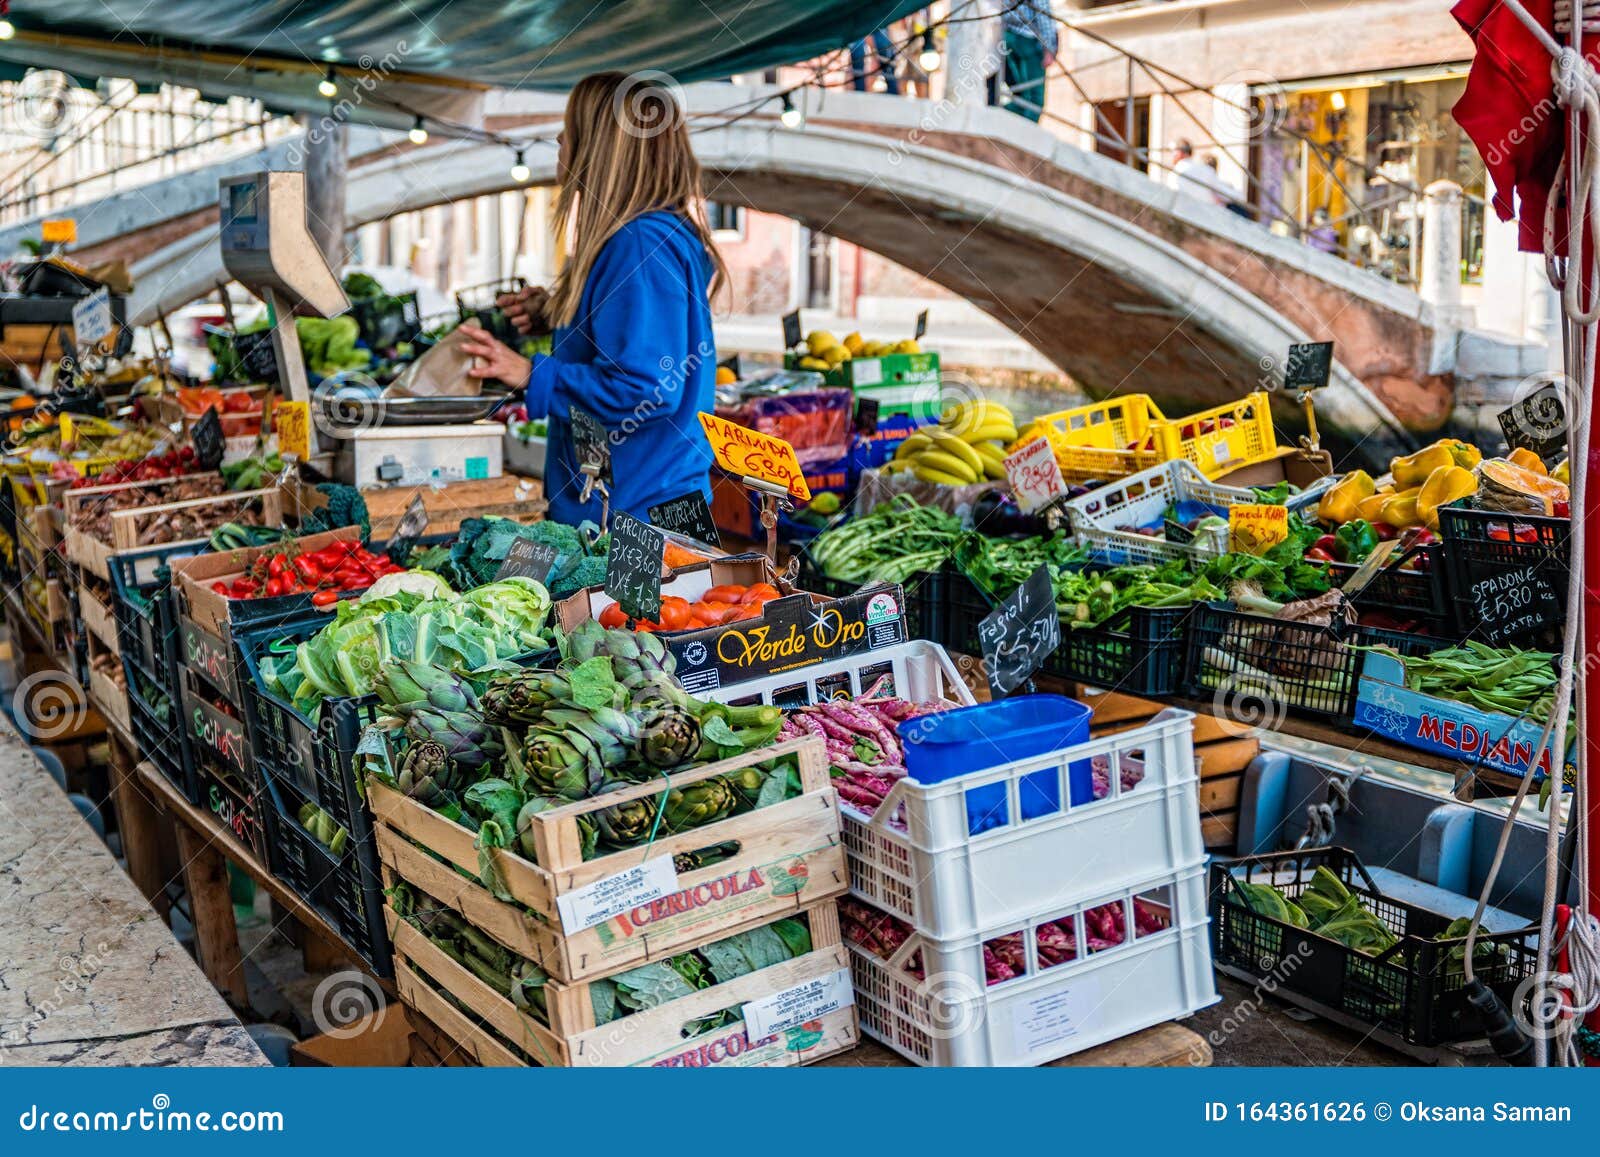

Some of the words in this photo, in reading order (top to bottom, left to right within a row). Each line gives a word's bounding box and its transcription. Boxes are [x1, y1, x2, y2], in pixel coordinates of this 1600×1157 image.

[1472, 566, 1537, 603] SPADONE
[717, 623, 806, 668] Verde
[812, 608, 865, 648] Oro
[1416, 713, 1552, 776] MEDIANA
[630, 866, 765, 926] CERICOLA
